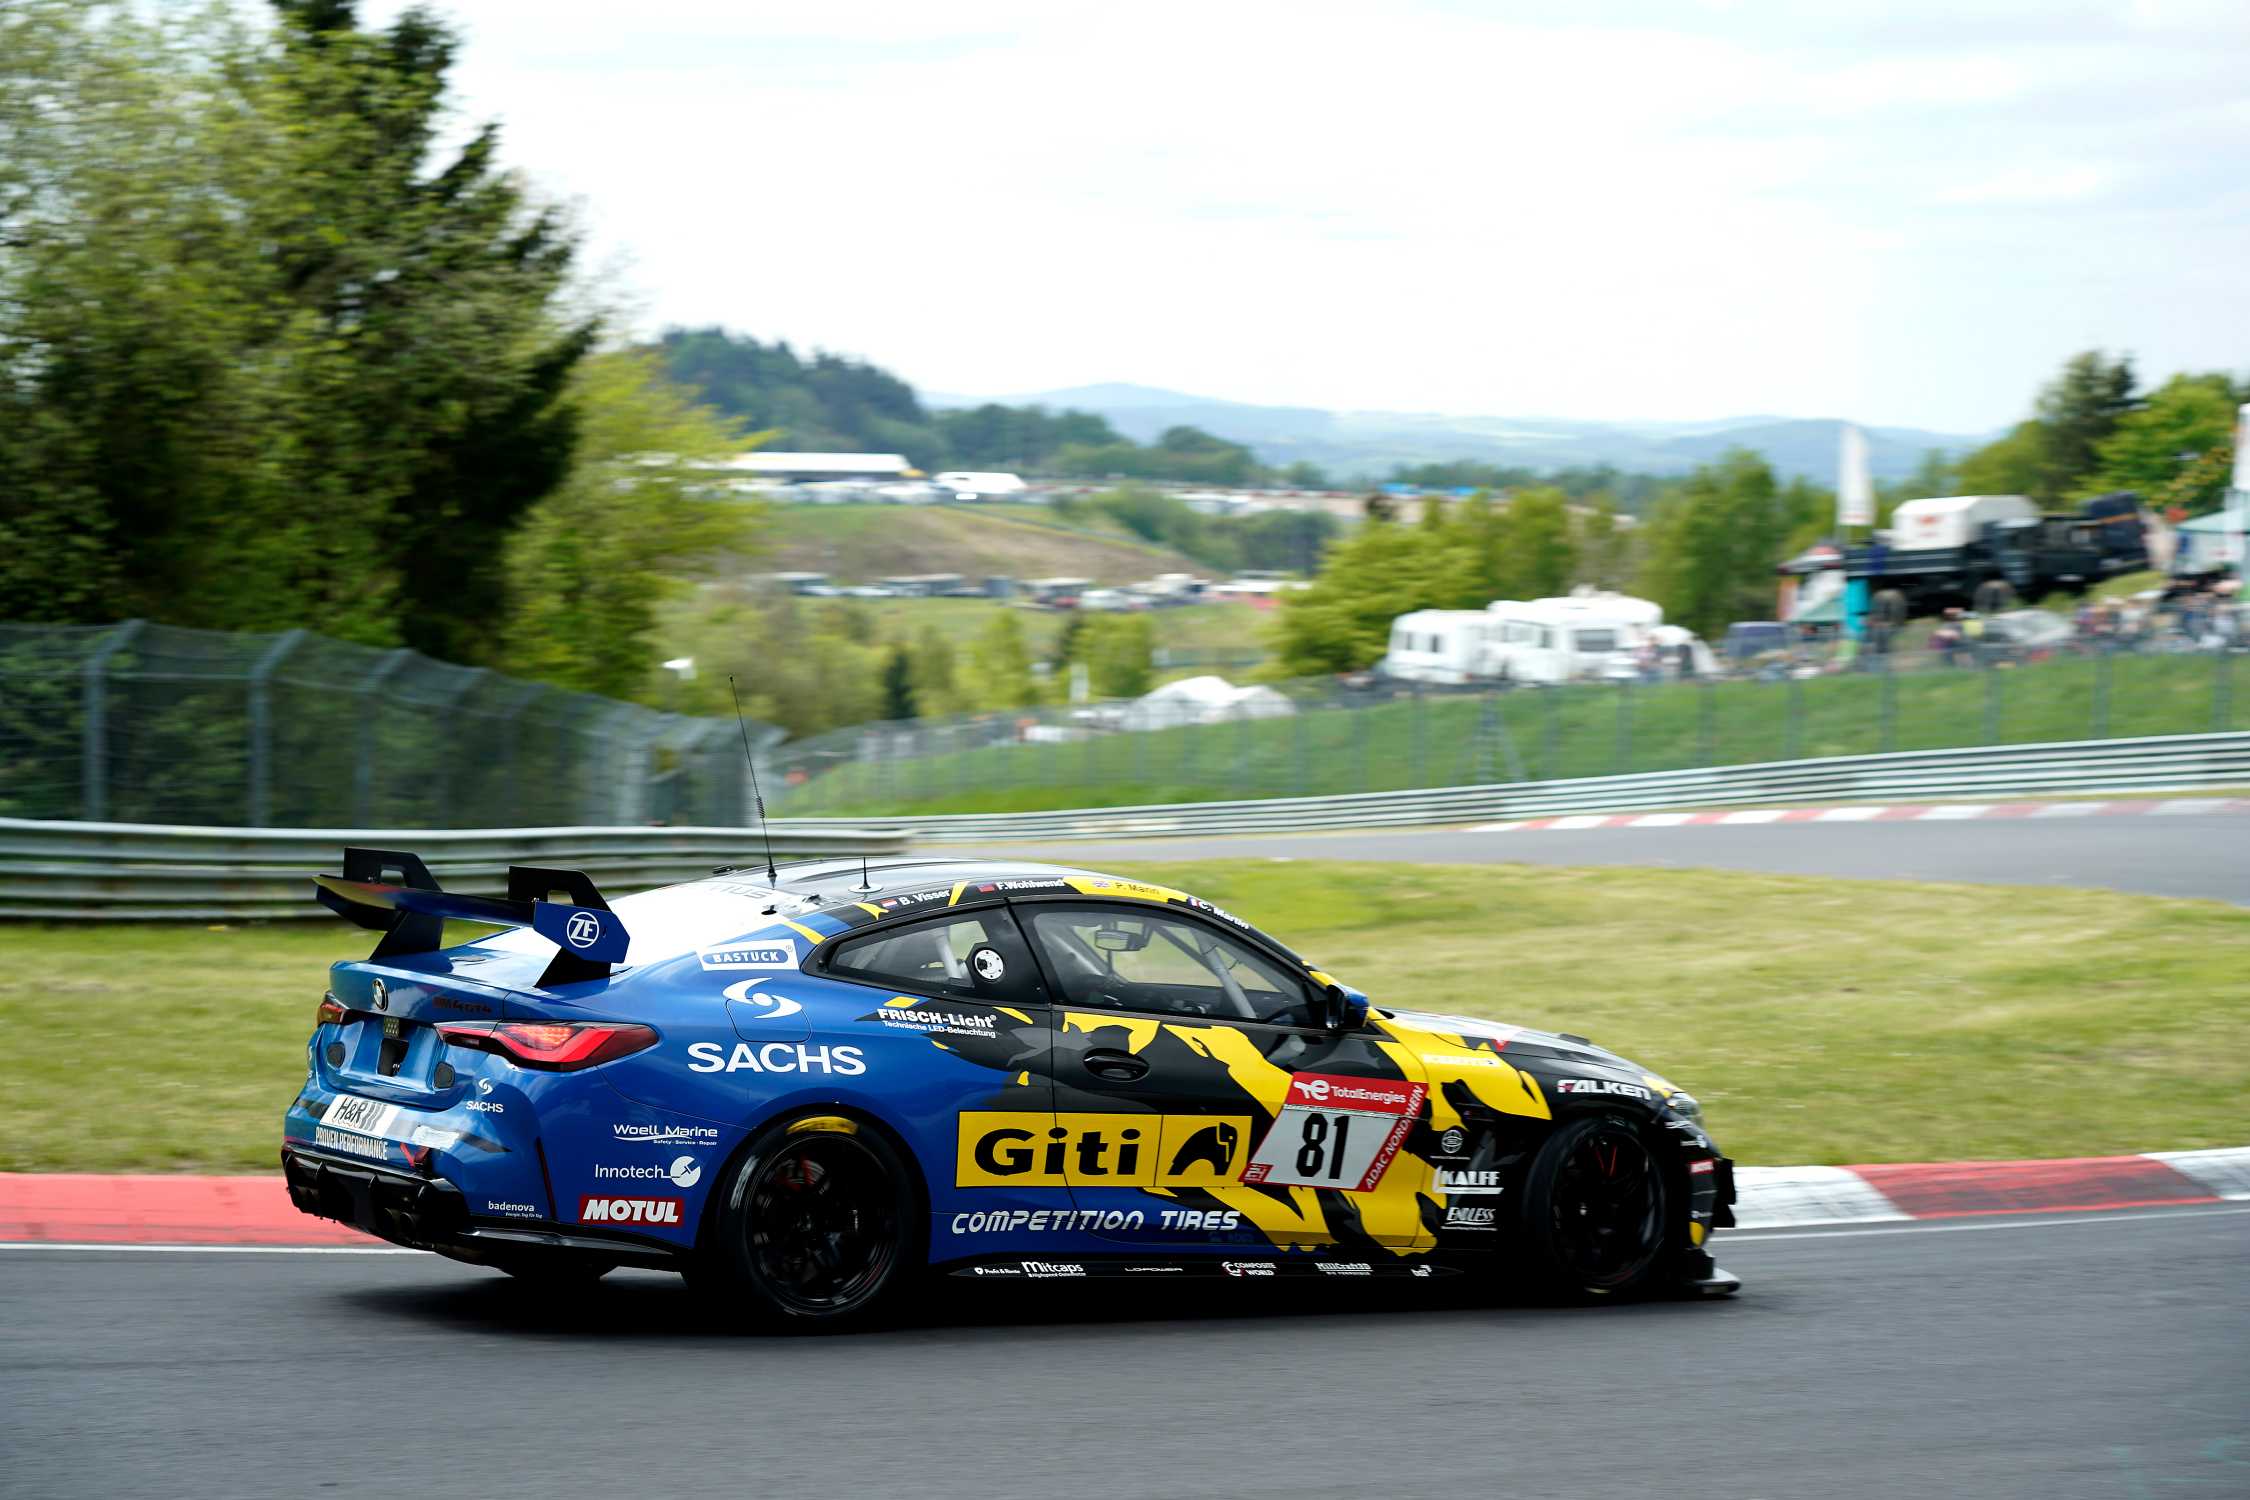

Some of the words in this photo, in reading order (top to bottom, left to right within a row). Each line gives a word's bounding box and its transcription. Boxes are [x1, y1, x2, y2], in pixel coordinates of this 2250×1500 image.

[912, 889, 950, 902] Visser
[570, 917, 597, 942] ZF
[712, 951, 779, 963] BASTUCK
[883, 1020, 927, 1031] Technische
[928, 1024, 996, 1039] LED-Beleuchtung
[687, 1042, 867, 1076] SACHS
[1331, 1085, 1407, 1105] TotalEnergies
[333, 1095, 368, 1122] H&R
[466, 1100, 504, 1113] SACHS
[613, 1124, 658, 1136] Woell
[665, 1125, 718, 1137] Marine
[315, 1126, 339, 1150] PROVEN
[339, 1132, 388, 1161] PERFORMANCE
[974, 1126, 1141, 1176] Giti
[1296, 1112, 1350, 1180] 81
[595, 1164, 664, 1179] Innotech
[1366, 1154, 1388, 1189] ADAC
[488, 1200, 535, 1212] badenova
[583, 1199, 679, 1223] MOTUL
[952, 1210, 1145, 1234] COMPETITION
[1160, 1210, 1241, 1231] TIRES
[1021, 1261, 1084, 1274] Mitcaps
